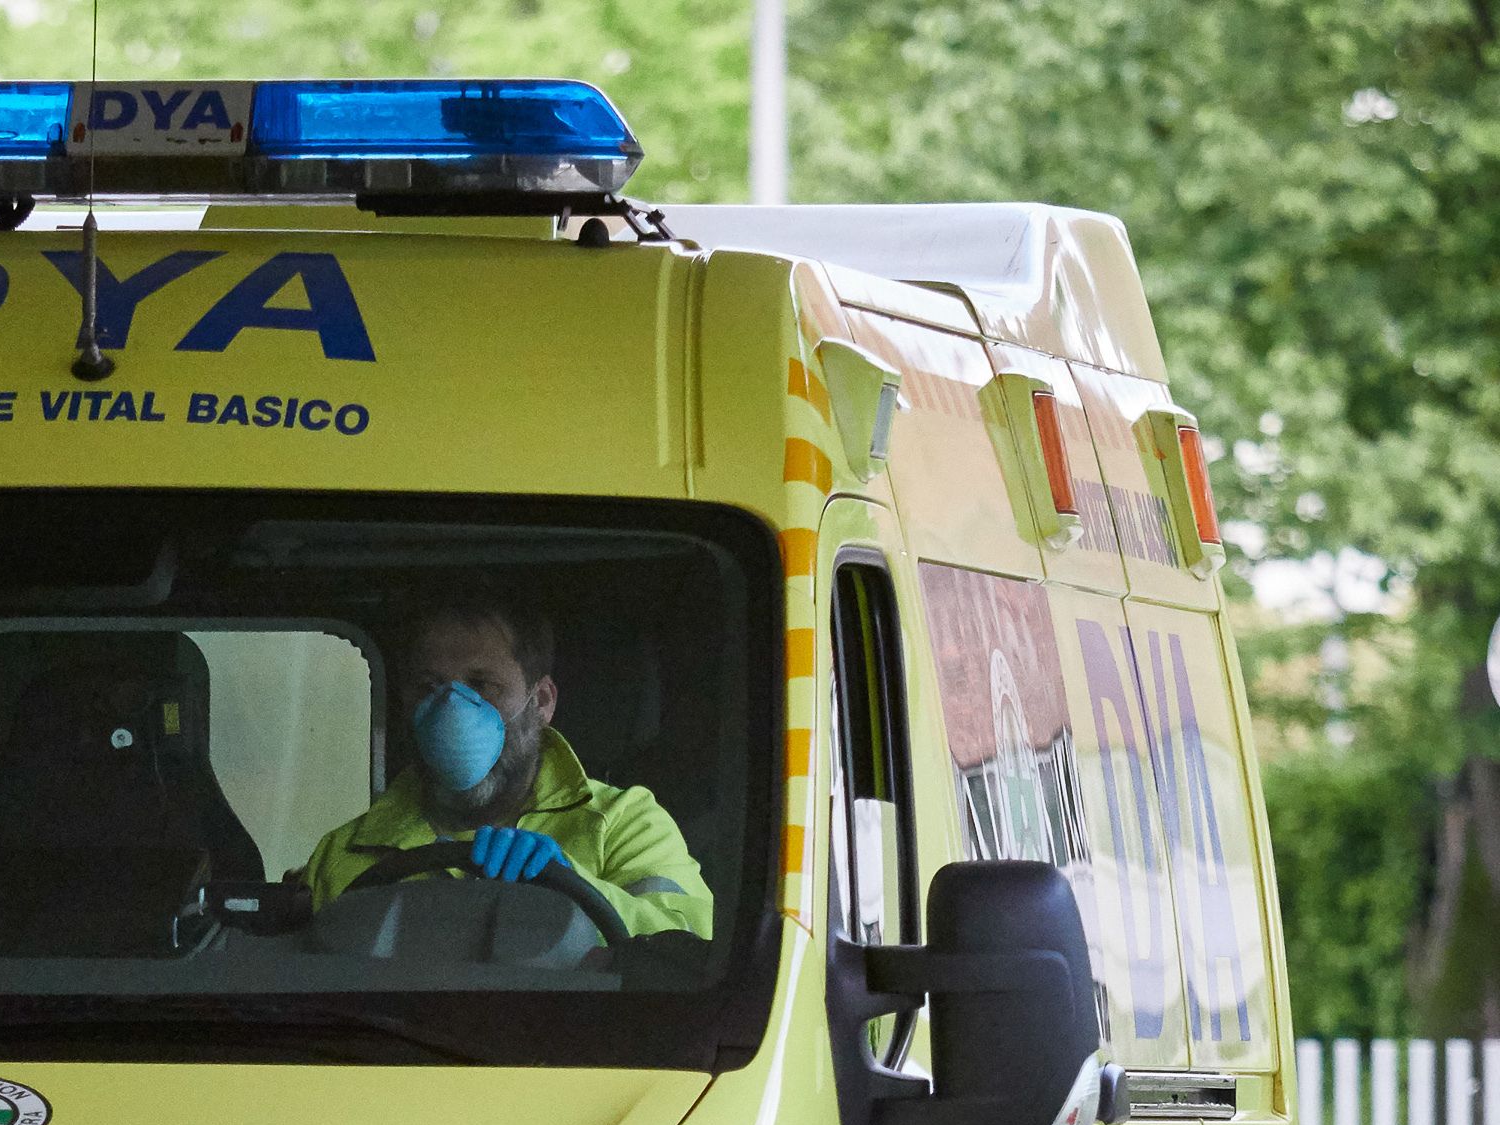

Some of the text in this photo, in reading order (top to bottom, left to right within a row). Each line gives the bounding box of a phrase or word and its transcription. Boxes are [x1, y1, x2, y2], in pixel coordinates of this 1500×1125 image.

[87, 89, 232, 131] DYA
[40, 392, 167, 422] VITAL
[188, 394, 370, 436] BASICO
[1077, 620, 1251, 1041] DYA
